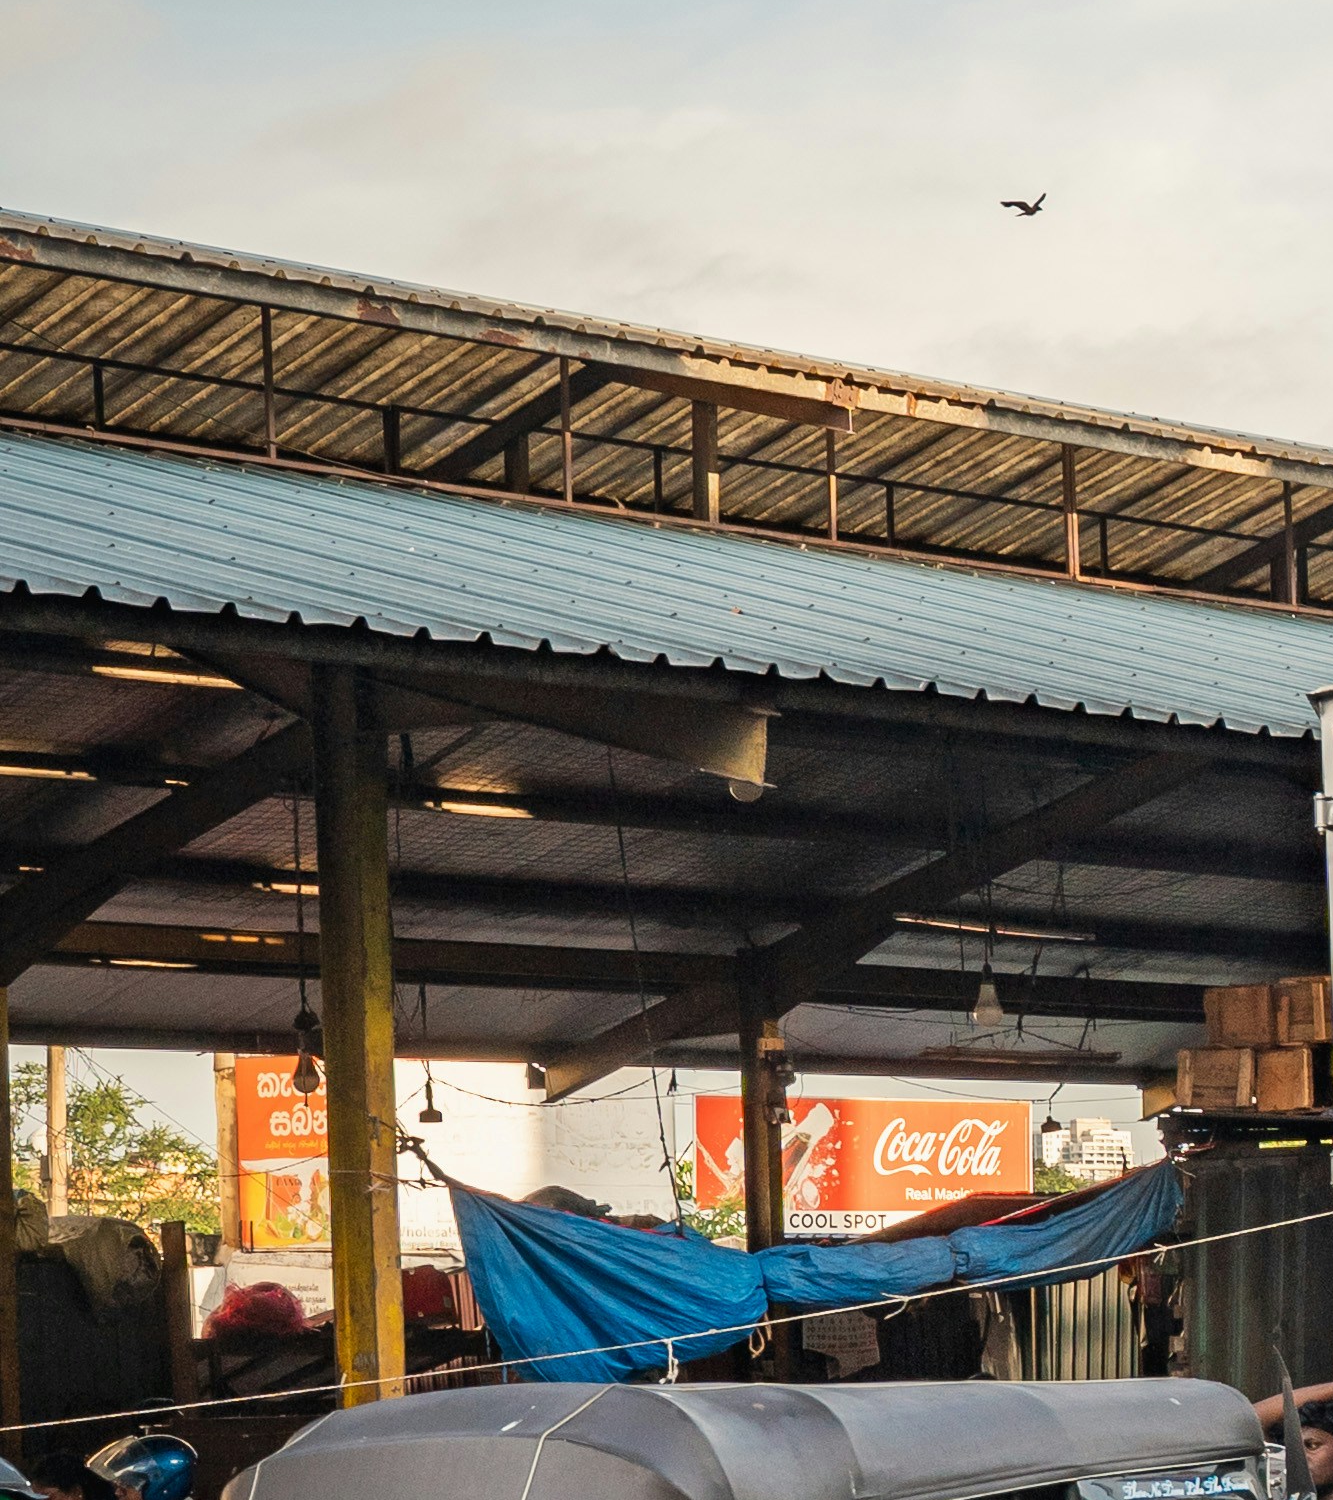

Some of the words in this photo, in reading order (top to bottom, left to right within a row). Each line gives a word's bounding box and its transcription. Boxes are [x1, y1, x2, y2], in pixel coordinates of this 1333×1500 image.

[873, 1117, 1009, 1176] Coca-Cola
[905, 1187, 932, 1201] Real
[789, 1213, 838, 1228] COOL
[843, 1214, 887, 1229] SPOT
